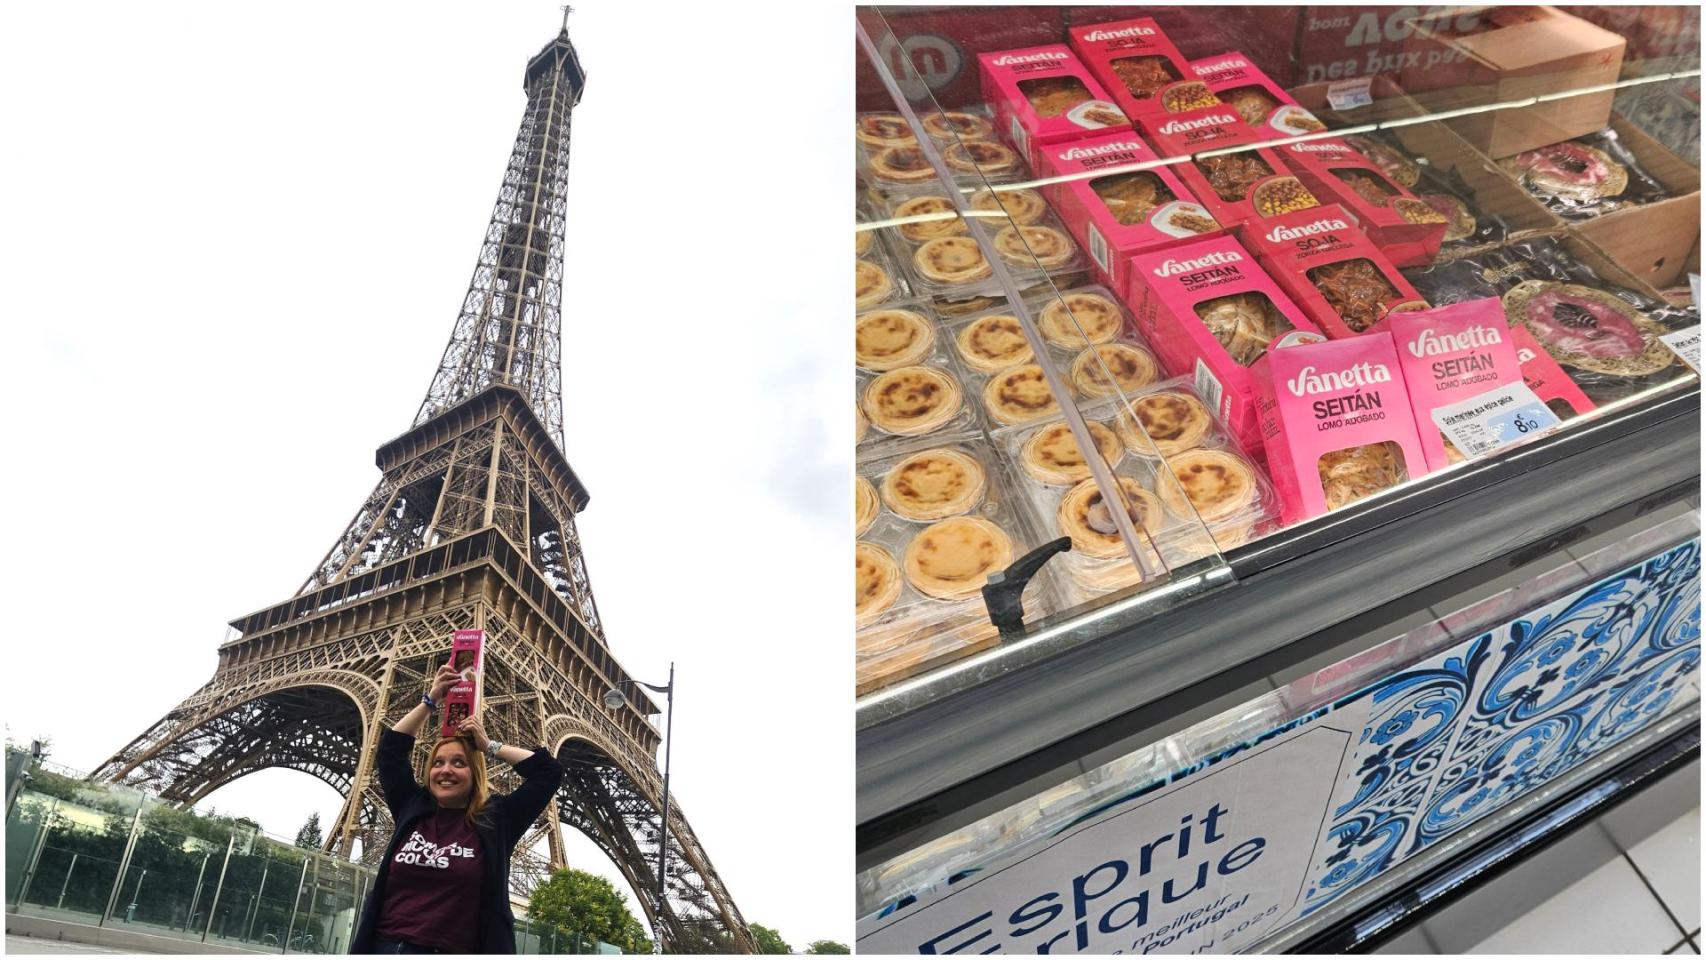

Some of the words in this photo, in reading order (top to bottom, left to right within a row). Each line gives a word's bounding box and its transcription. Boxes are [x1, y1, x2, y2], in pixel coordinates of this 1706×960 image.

[1083, 27, 1156, 42] Vanetta
[992, 52, 1069, 66] Vanetta
[1158, 114, 1237, 134] Vanetta
[1059, 142, 1141, 160] Vanetta
[1265, 219, 1348, 243] Vanetta
[1296, 235, 1341, 251] SOJA
[1153, 251, 1243, 277] Vanetta
[1180, 265, 1240, 286] SEITÁN
[1408, 325, 1502, 358] Vanetta
[1431, 350, 1494, 380] SEITÁN
[1287, 361, 1392, 397] Vanetta
[1436, 380, 1459, 391] LOMO
[1461, 372, 1498, 386] ADOBADO
[1313, 389, 1382, 420] SEITÁN
[1317, 420, 1343, 431] LOMO
[1345, 411, 1386, 427] ADOBADO
[918, 803, 1229, 955] Esprit
[1132, 893, 1232, 950] meilleur
[1222, 903, 1279, 941] 2025
